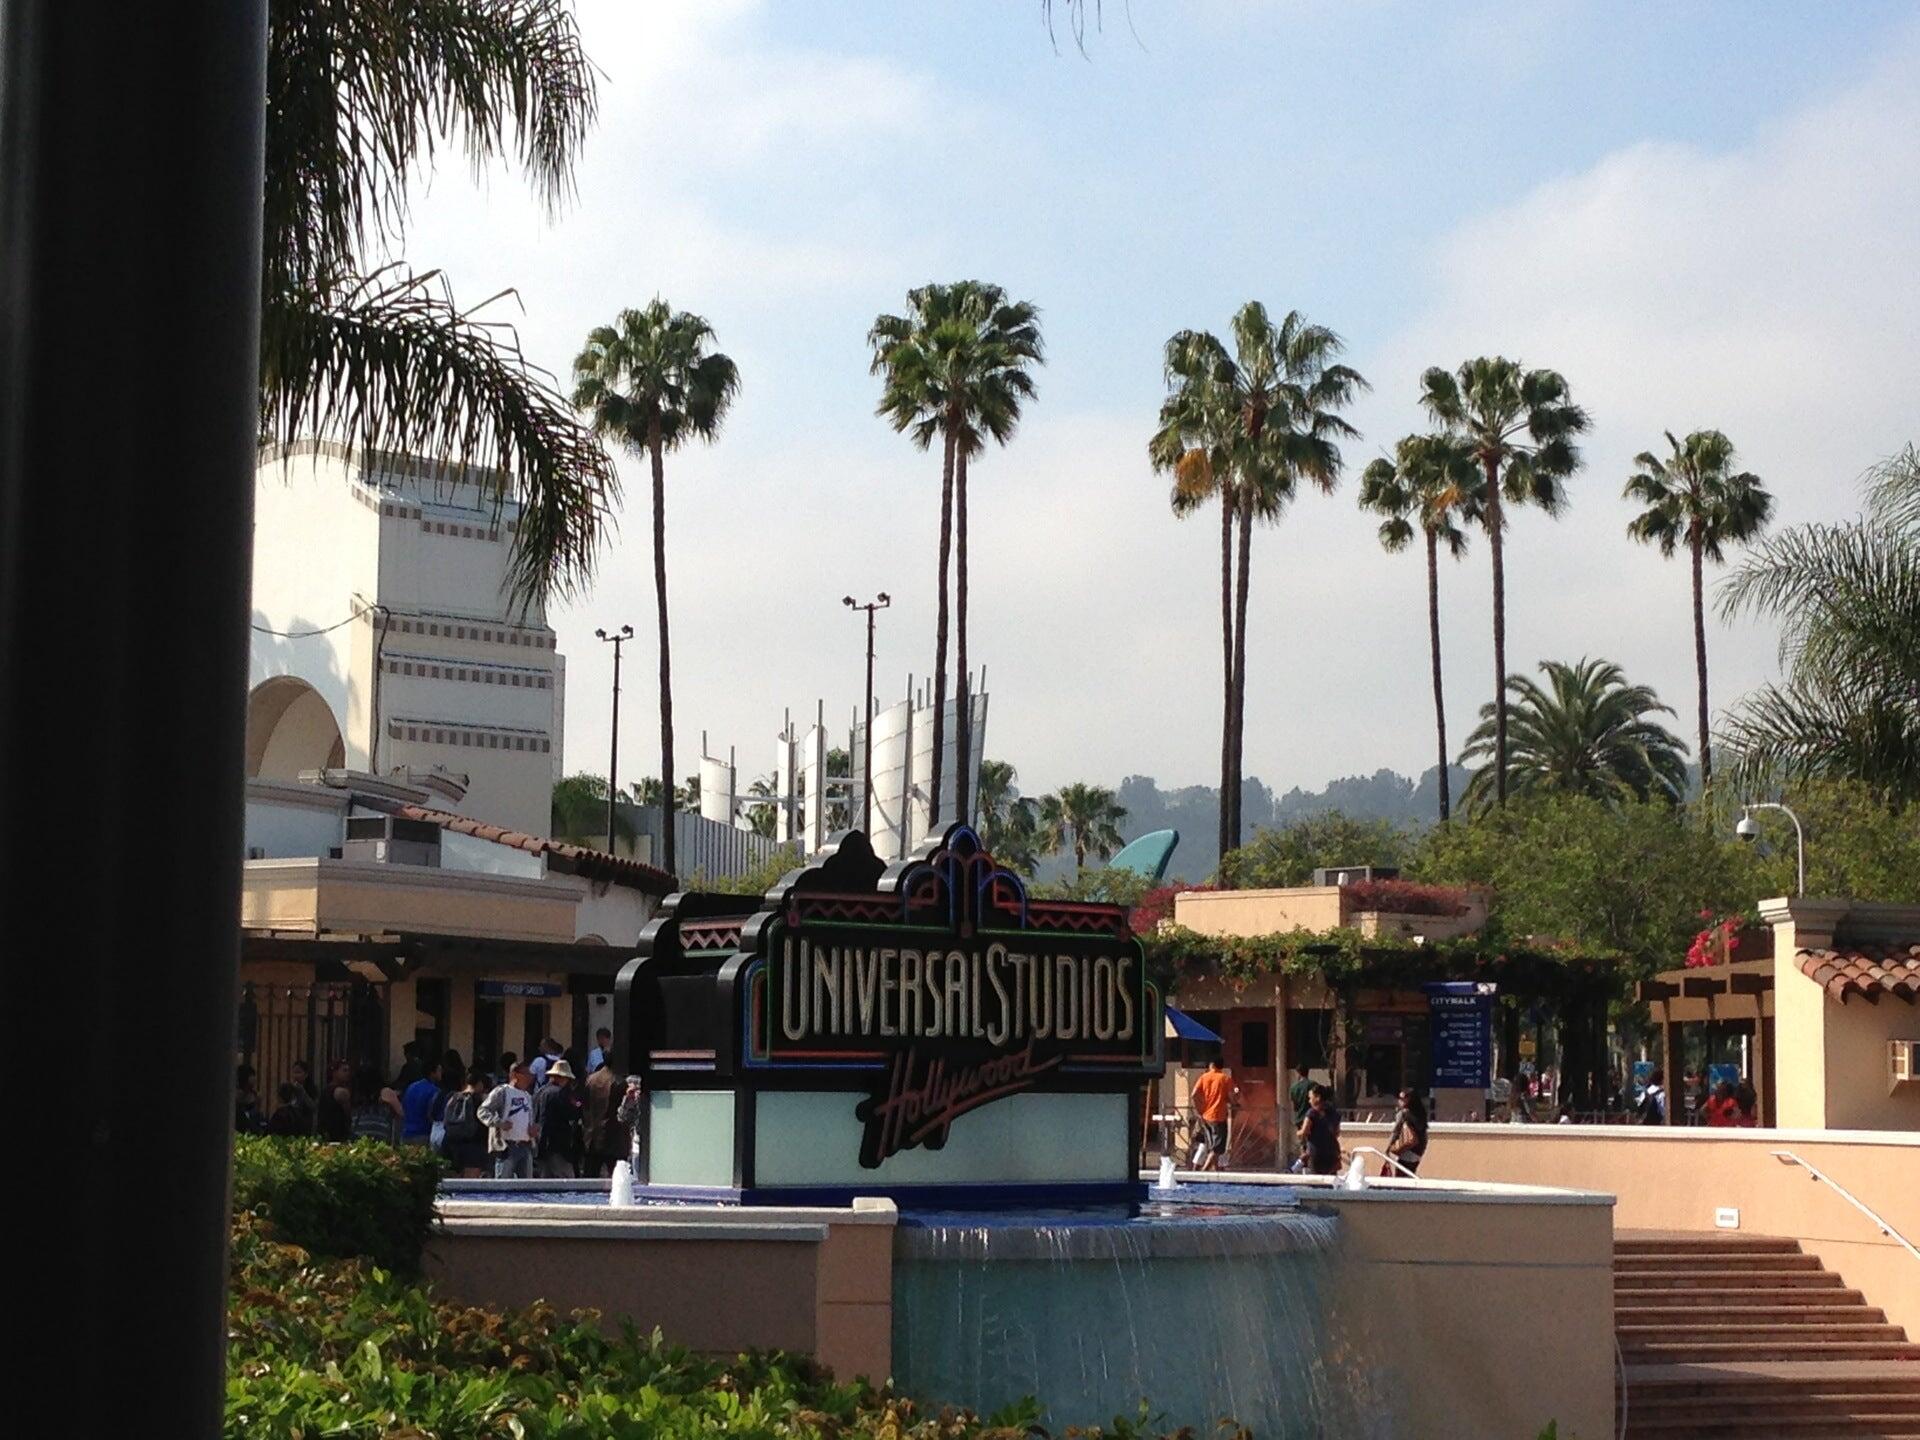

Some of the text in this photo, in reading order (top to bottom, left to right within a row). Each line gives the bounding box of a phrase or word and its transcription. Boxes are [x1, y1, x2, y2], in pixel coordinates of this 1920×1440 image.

[986, 942, 1134, 1047] STUDIOS
[1431, 996, 1477, 1005] CITYWALK
[873, 1030, 1065, 1162] Hollywood
